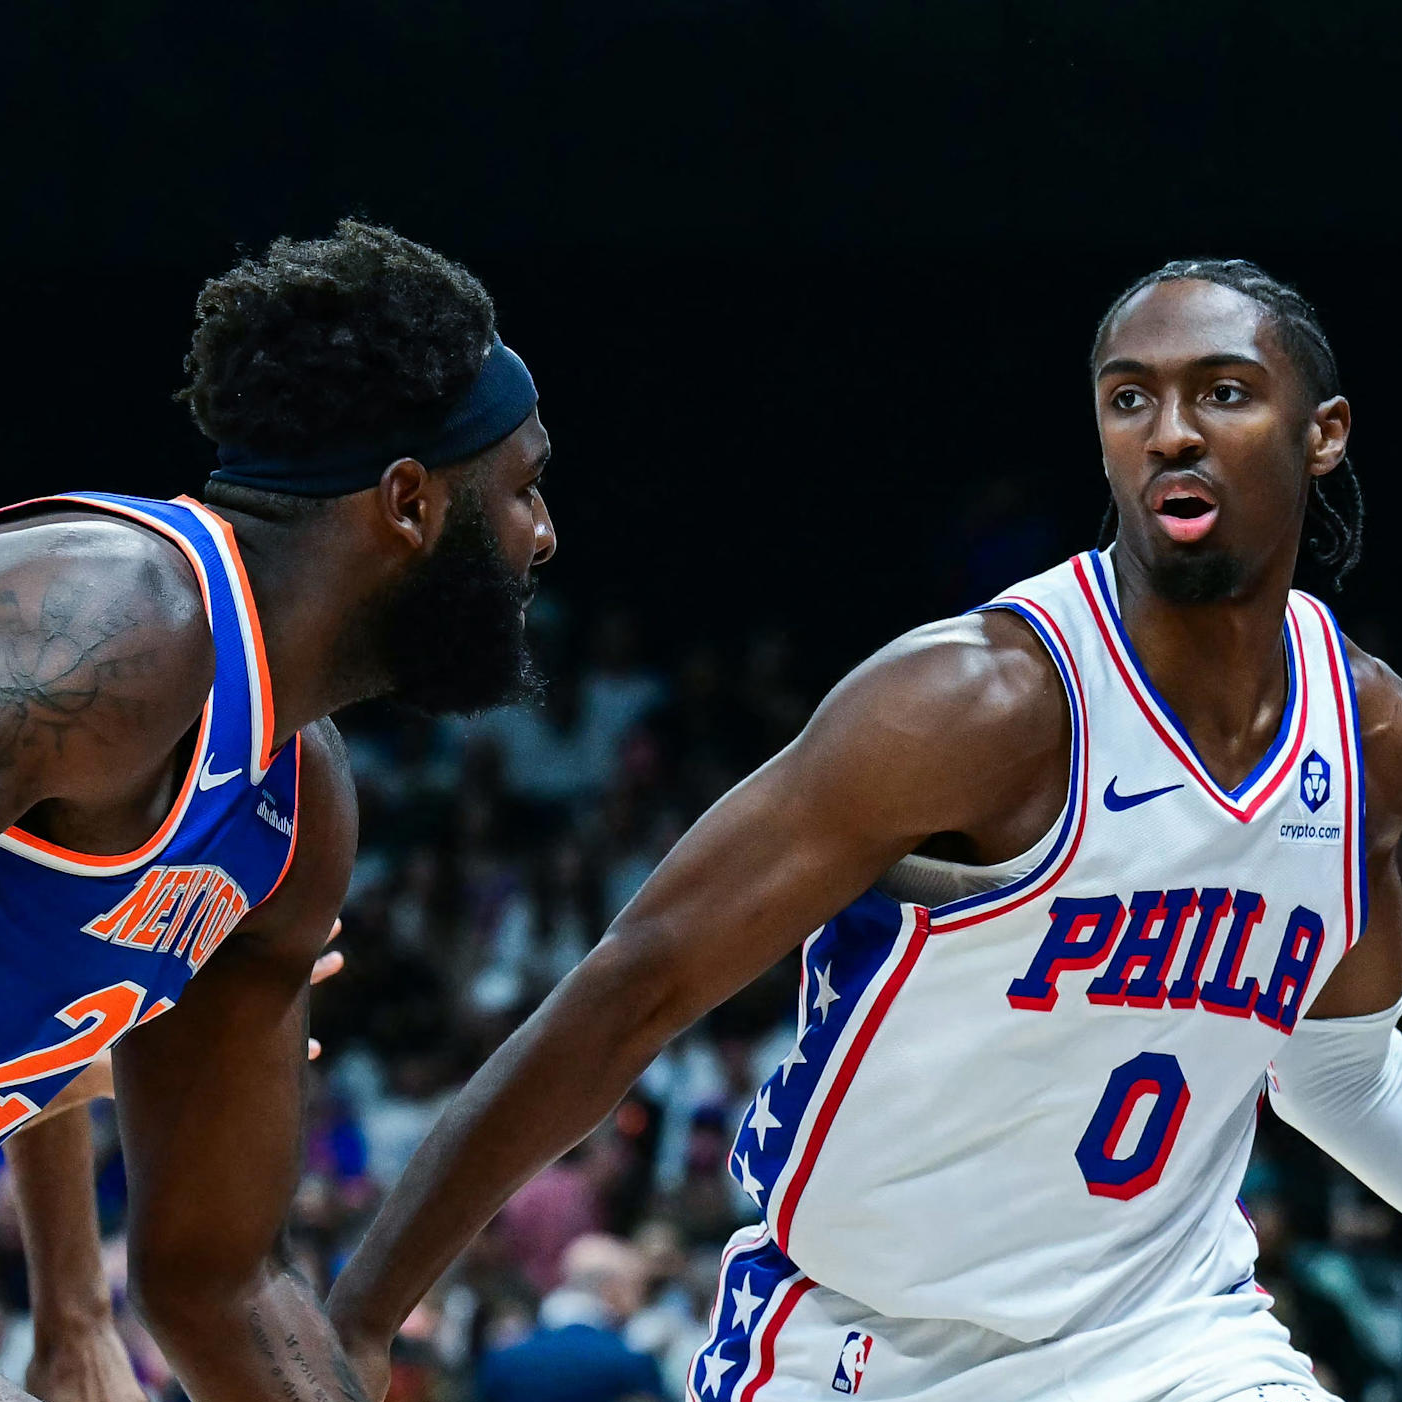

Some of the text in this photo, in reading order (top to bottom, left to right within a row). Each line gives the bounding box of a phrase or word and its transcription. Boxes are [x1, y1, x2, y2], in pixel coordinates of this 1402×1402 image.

[1280, 824, 1340, 840] crypto.com
[1006, 887, 1325, 1036] PHILA
[1075, 1051, 1191, 1202] 0
[834, 1377, 849, 1391] NBA
